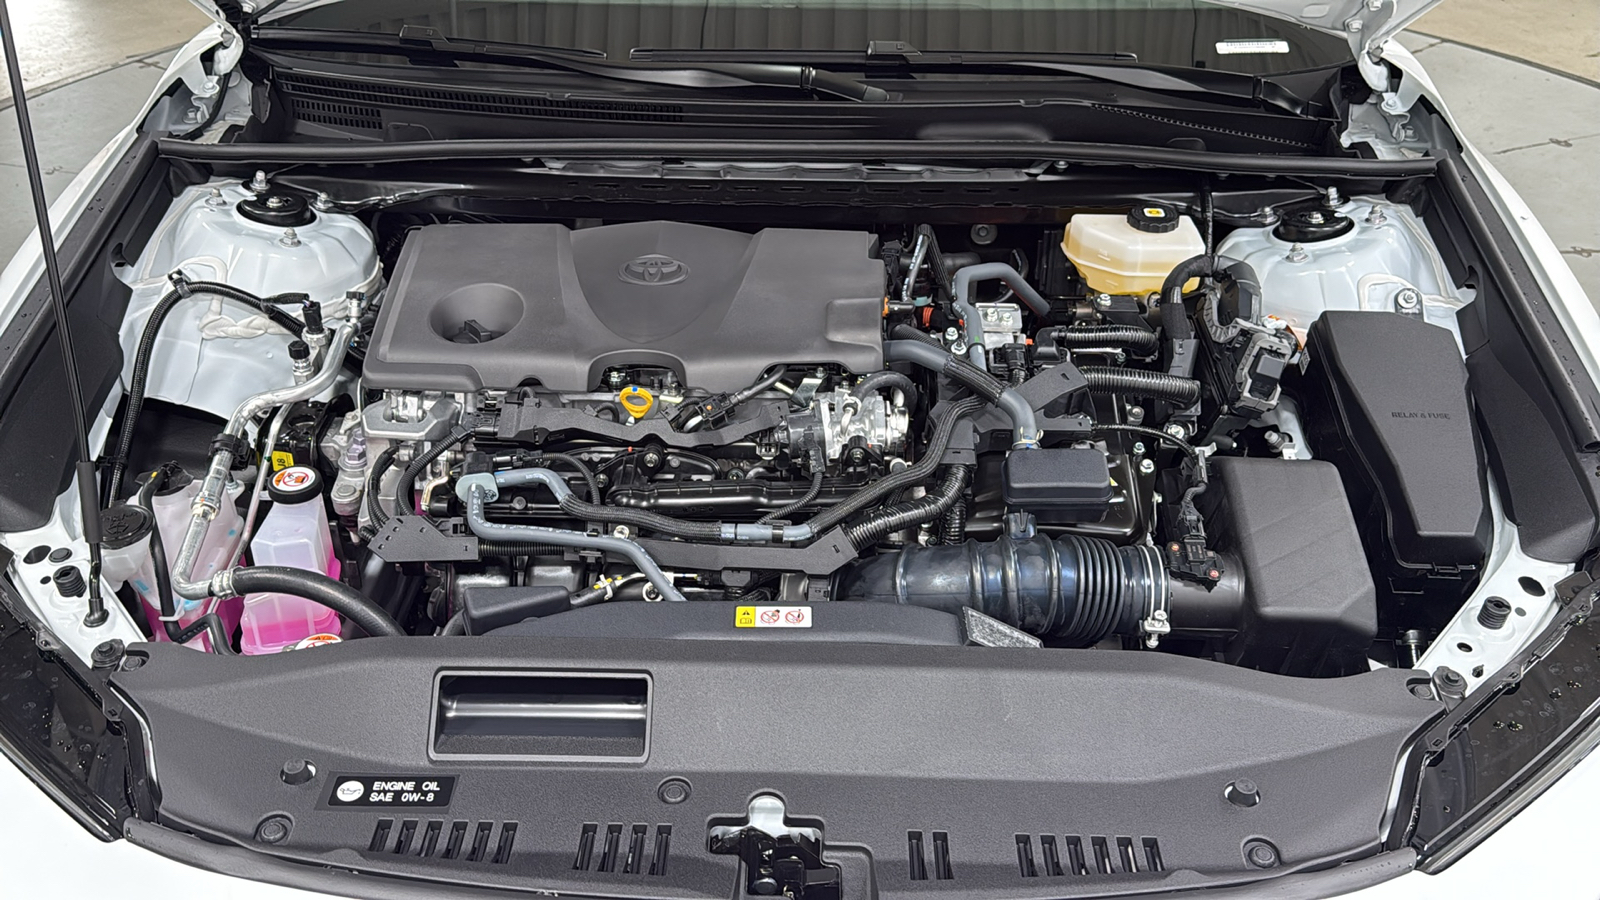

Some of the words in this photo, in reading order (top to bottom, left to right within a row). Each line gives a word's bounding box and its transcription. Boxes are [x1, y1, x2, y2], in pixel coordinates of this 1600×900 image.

[1427, 412, 1451, 420] FUSE
[372, 781, 416, 791] ENGINE
[421, 781, 440, 791] OIL
[369, 792, 394, 802] SAE
[401, 792, 435, 802] 0W-8
